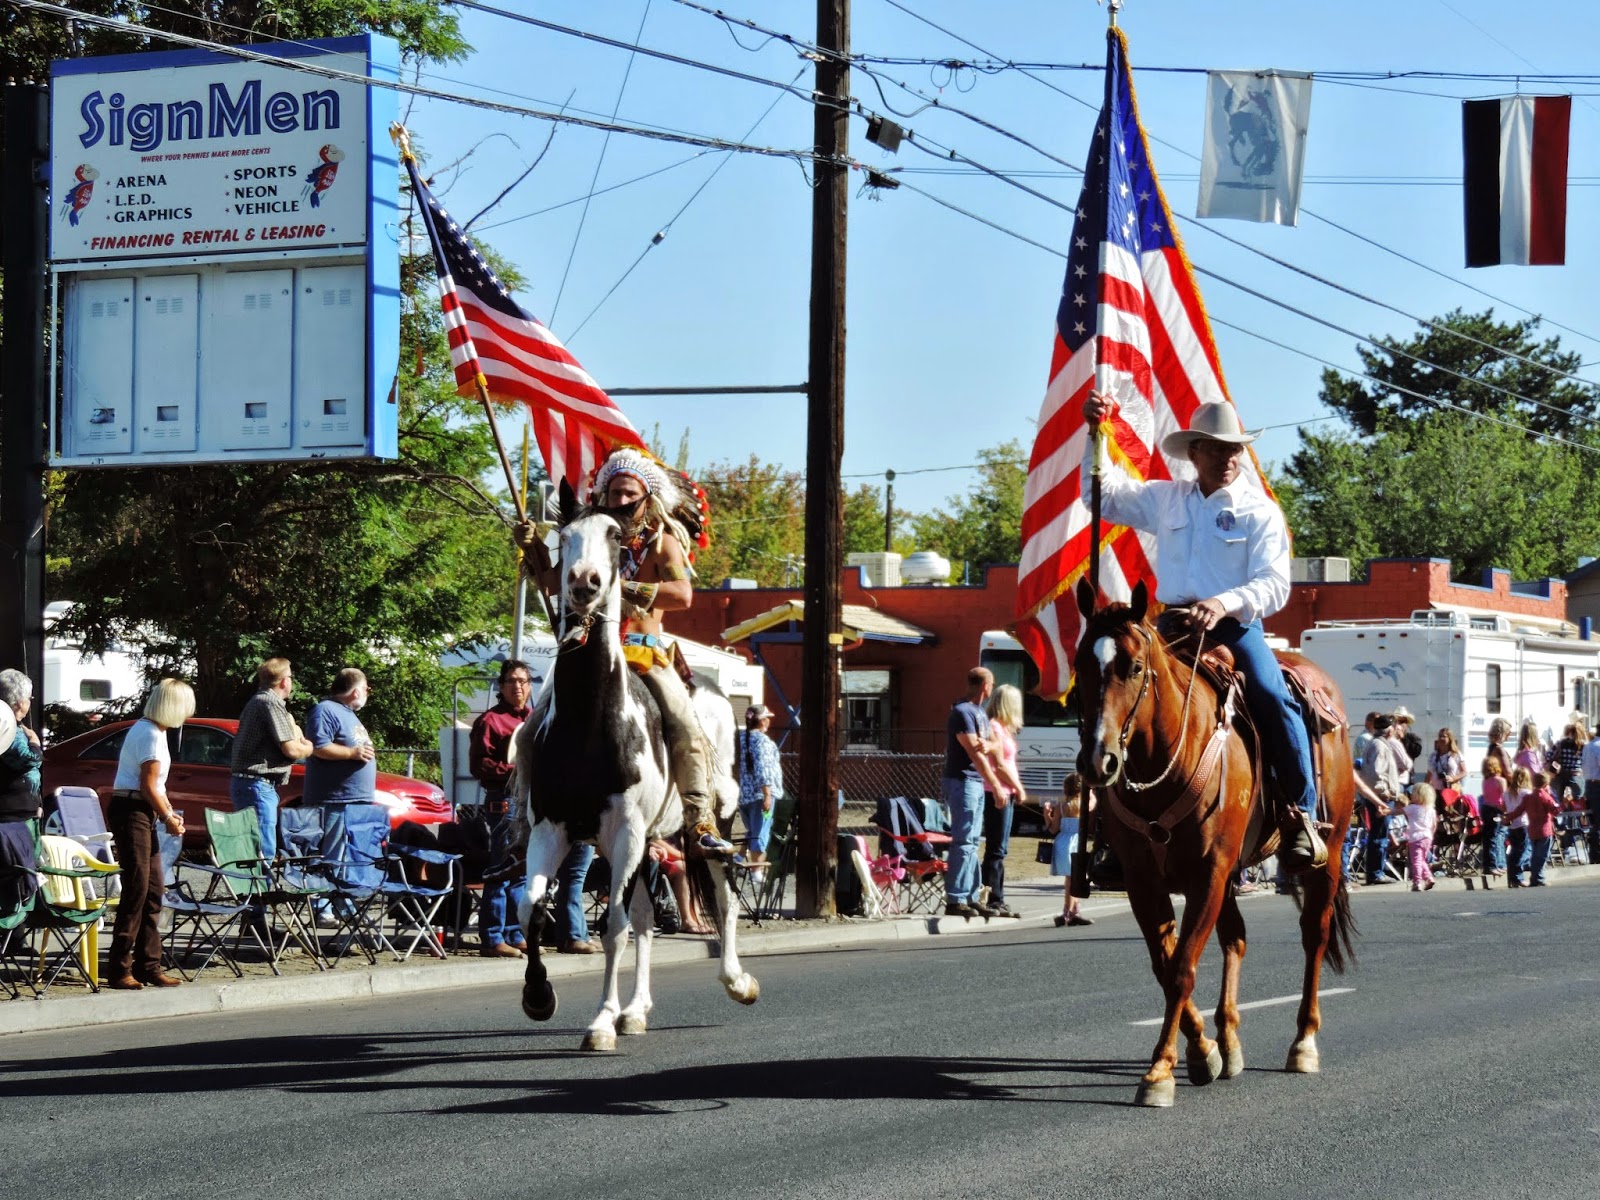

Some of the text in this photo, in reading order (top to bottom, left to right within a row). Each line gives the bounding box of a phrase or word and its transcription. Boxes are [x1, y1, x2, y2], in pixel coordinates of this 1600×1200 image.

[78, 79, 340, 152] SignMen
[141, 147, 271, 163] WHERE YOUR PENNIES MAKE MORE CENTS
[234, 165, 297, 181] SPORTS
[116, 174, 167, 188] ARENA
[116, 193, 156, 206] L.E.D.
[235, 185, 278, 199] NEON
[114, 207, 193, 223] GRAPHICS
[234, 200, 300, 215] VEHICLE
[91, 224, 326, 250] FINANCING RENTAL & LEASING
[498, 643, 551, 655] CGAR
